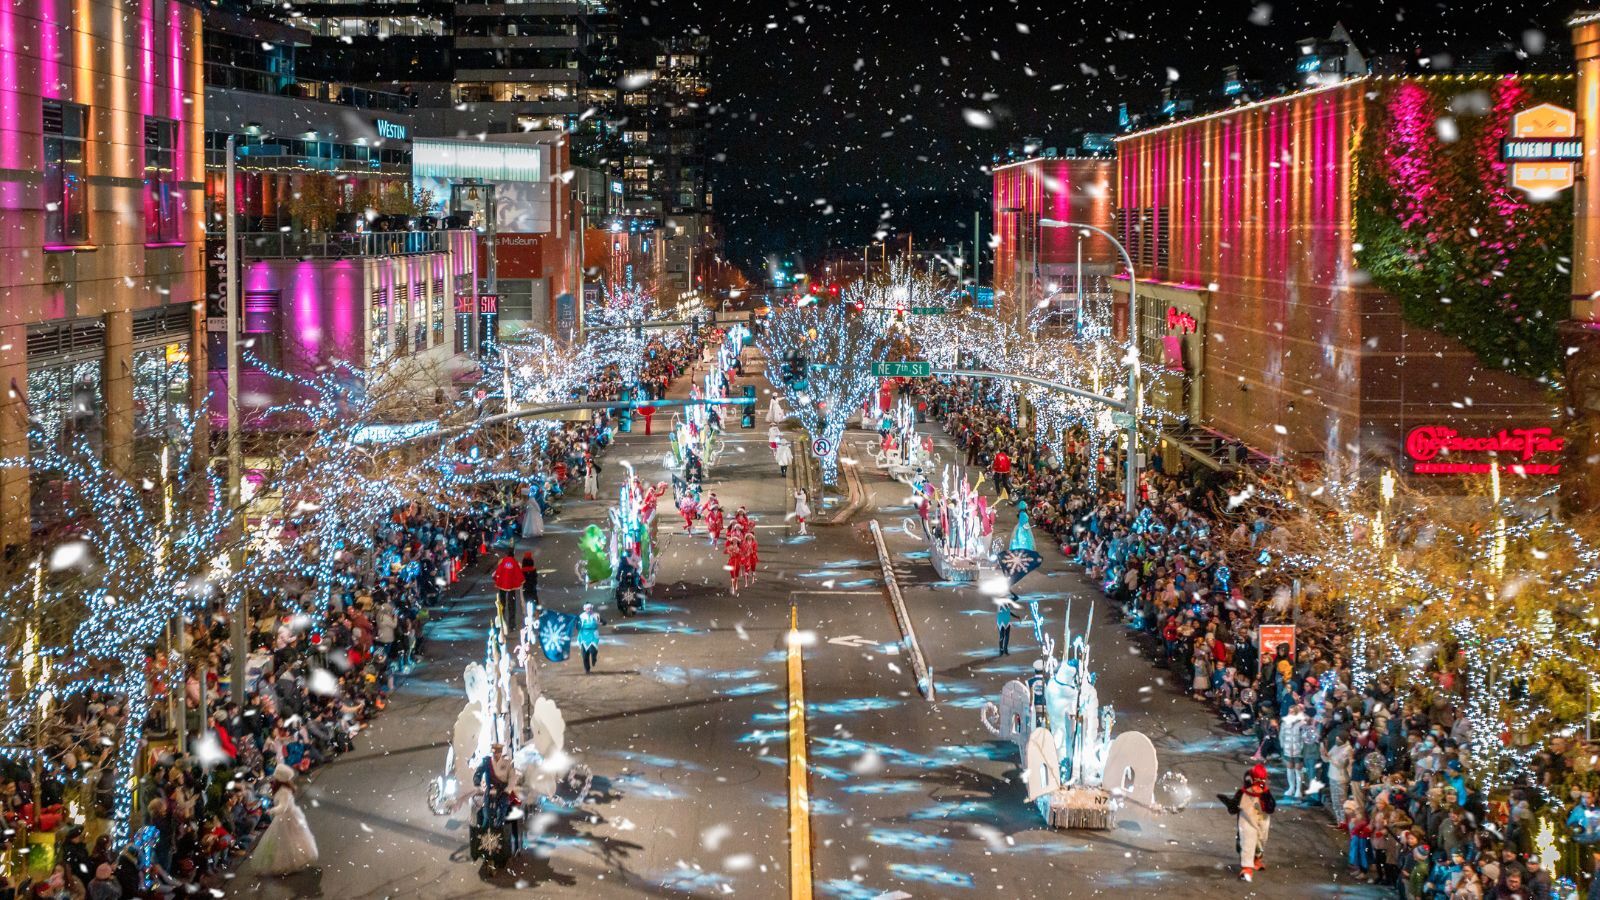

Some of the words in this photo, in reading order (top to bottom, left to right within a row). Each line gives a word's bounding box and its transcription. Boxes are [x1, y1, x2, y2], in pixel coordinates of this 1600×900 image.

[377, 119, 405, 140] WESTIN
[1505, 141, 1552, 158] TAVERN
[1553, 141, 1584, 158] HALL
[501, 236, 538, 246] Museum
[878, 364, 891, 375] NE
[894, 364, 909, 375] 7th
[912, 364, 923, 375] St
[1407, 426, 1525, 461] Cheesecake
[1094, 796, 1109, 805] N7
